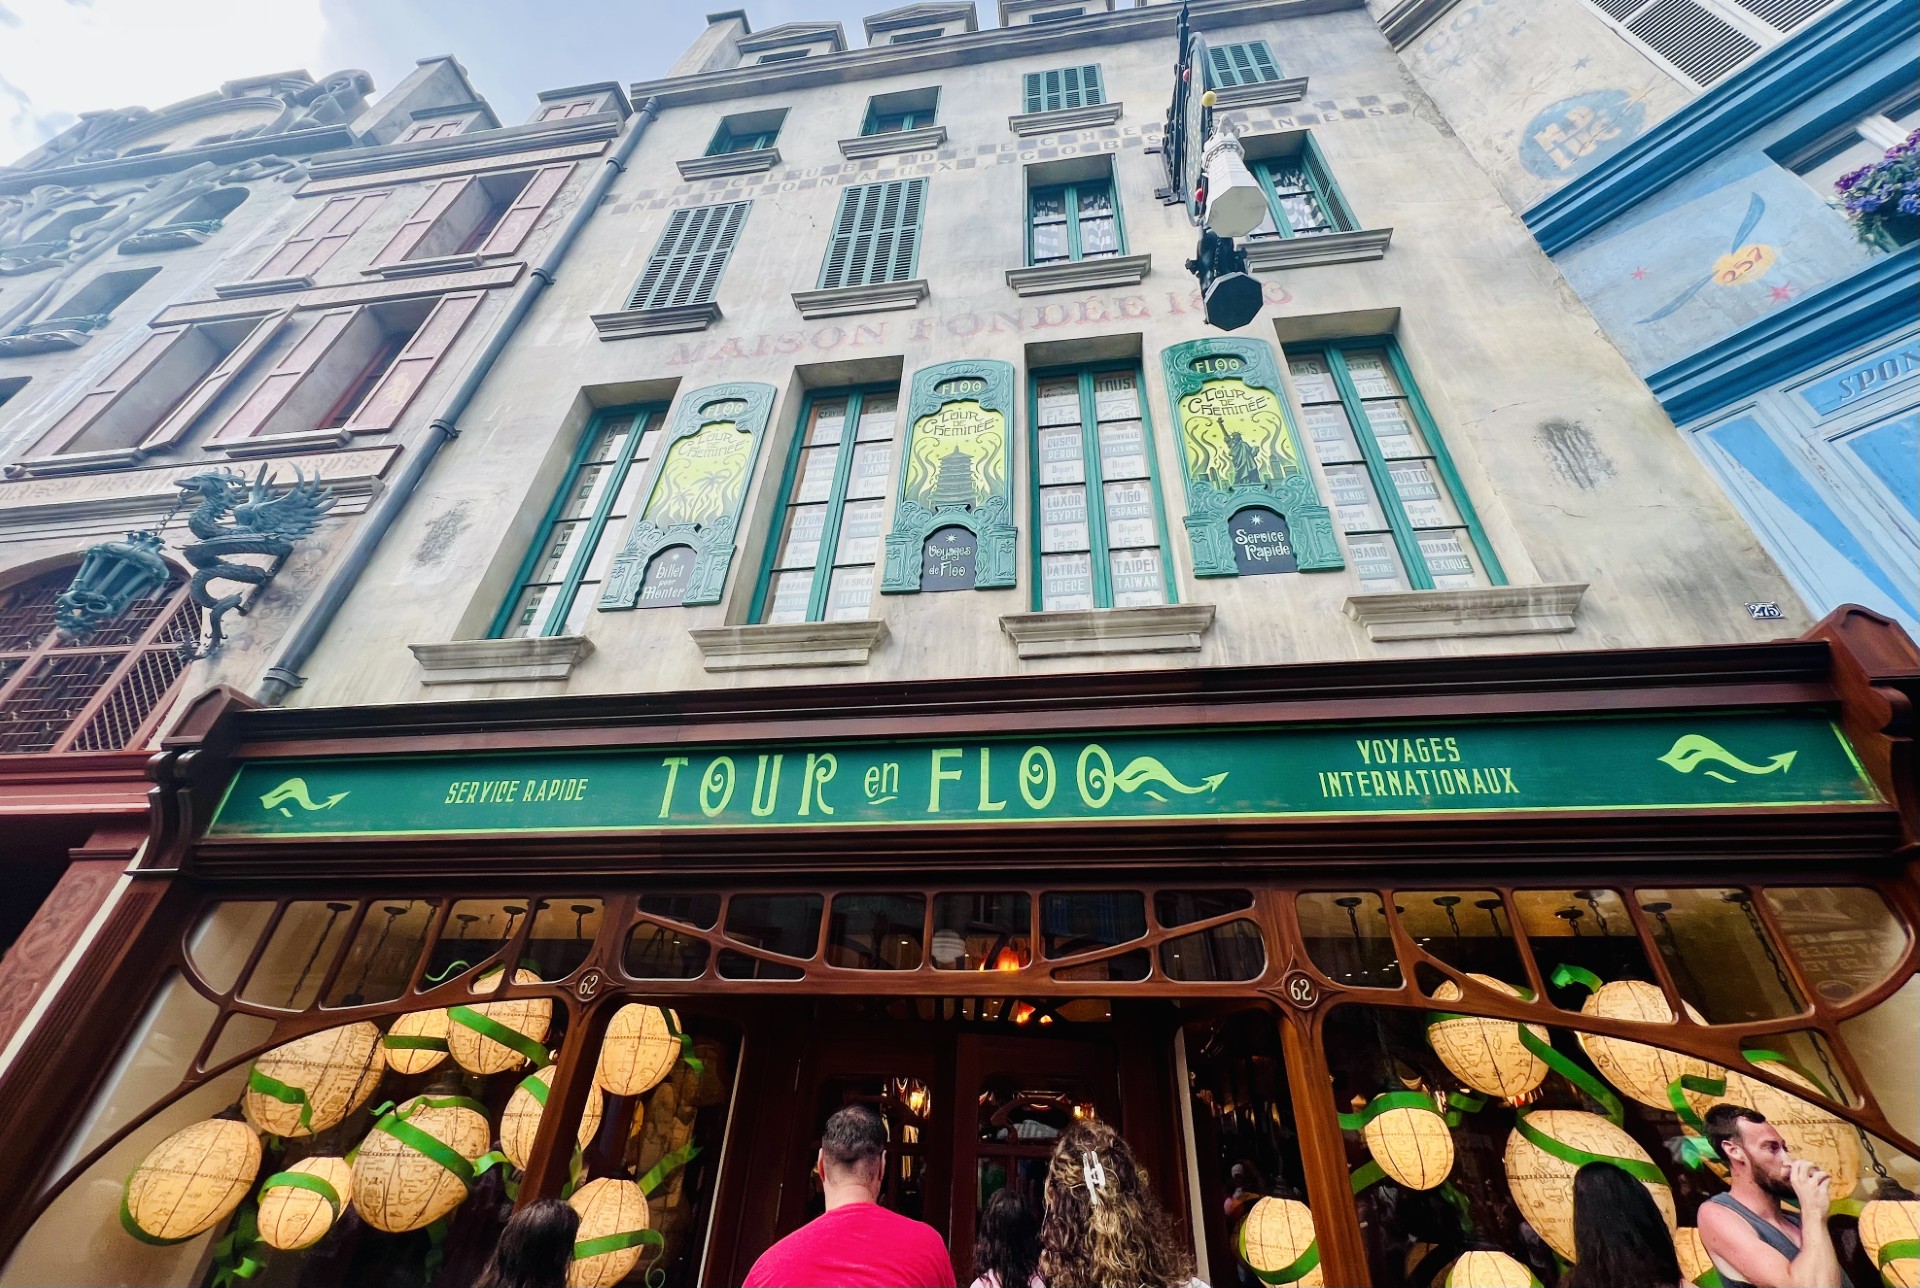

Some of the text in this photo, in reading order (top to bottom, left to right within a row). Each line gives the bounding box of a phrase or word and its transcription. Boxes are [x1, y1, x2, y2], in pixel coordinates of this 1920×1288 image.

[1722, 246, 1763, 282] 257
[665, 321, 889, 366] MAISON
[906, 294, 1151, 341] FONDÉE
[1195, 358, 1240, 374] FLOO
[941, 380, 982, 395] FLOO
[1201, 387, 1253, 401] TOUR
[704, 402, 744, 417] FLOO
[938, 409, 982, 424] TOUR
[952, 419, 966, 427] DE
[696, 430, 737, 445] TOUR
[1047, 494, 1082, 508] LUXOR
[1114, 489, 1141, 504] VIGO
[1109, 505, 1149, 518] ESPAGNE
[928, 544, 971, 562] Voyages
[1244, 542, 1291, 561] Rapide
[1421, 542, 1463, 555] RUAPAN
[928, 561, 966, 577] de Floo
[1046, 562, 1088, 577] PATRAS
[1749, 604, 1780, 617] 275
[1355, 736, 1462, 764] VOYAGES
[658, 743, 1115, 819] TOUR en FLOO
[1318, 767, 1520, 798] INTERNATIONAUX
[444, 778, 589, 804] SERVICE RAPIDE
[578, 974, 599, 995] 62
[1290, 978, 1312, 1001] 62
